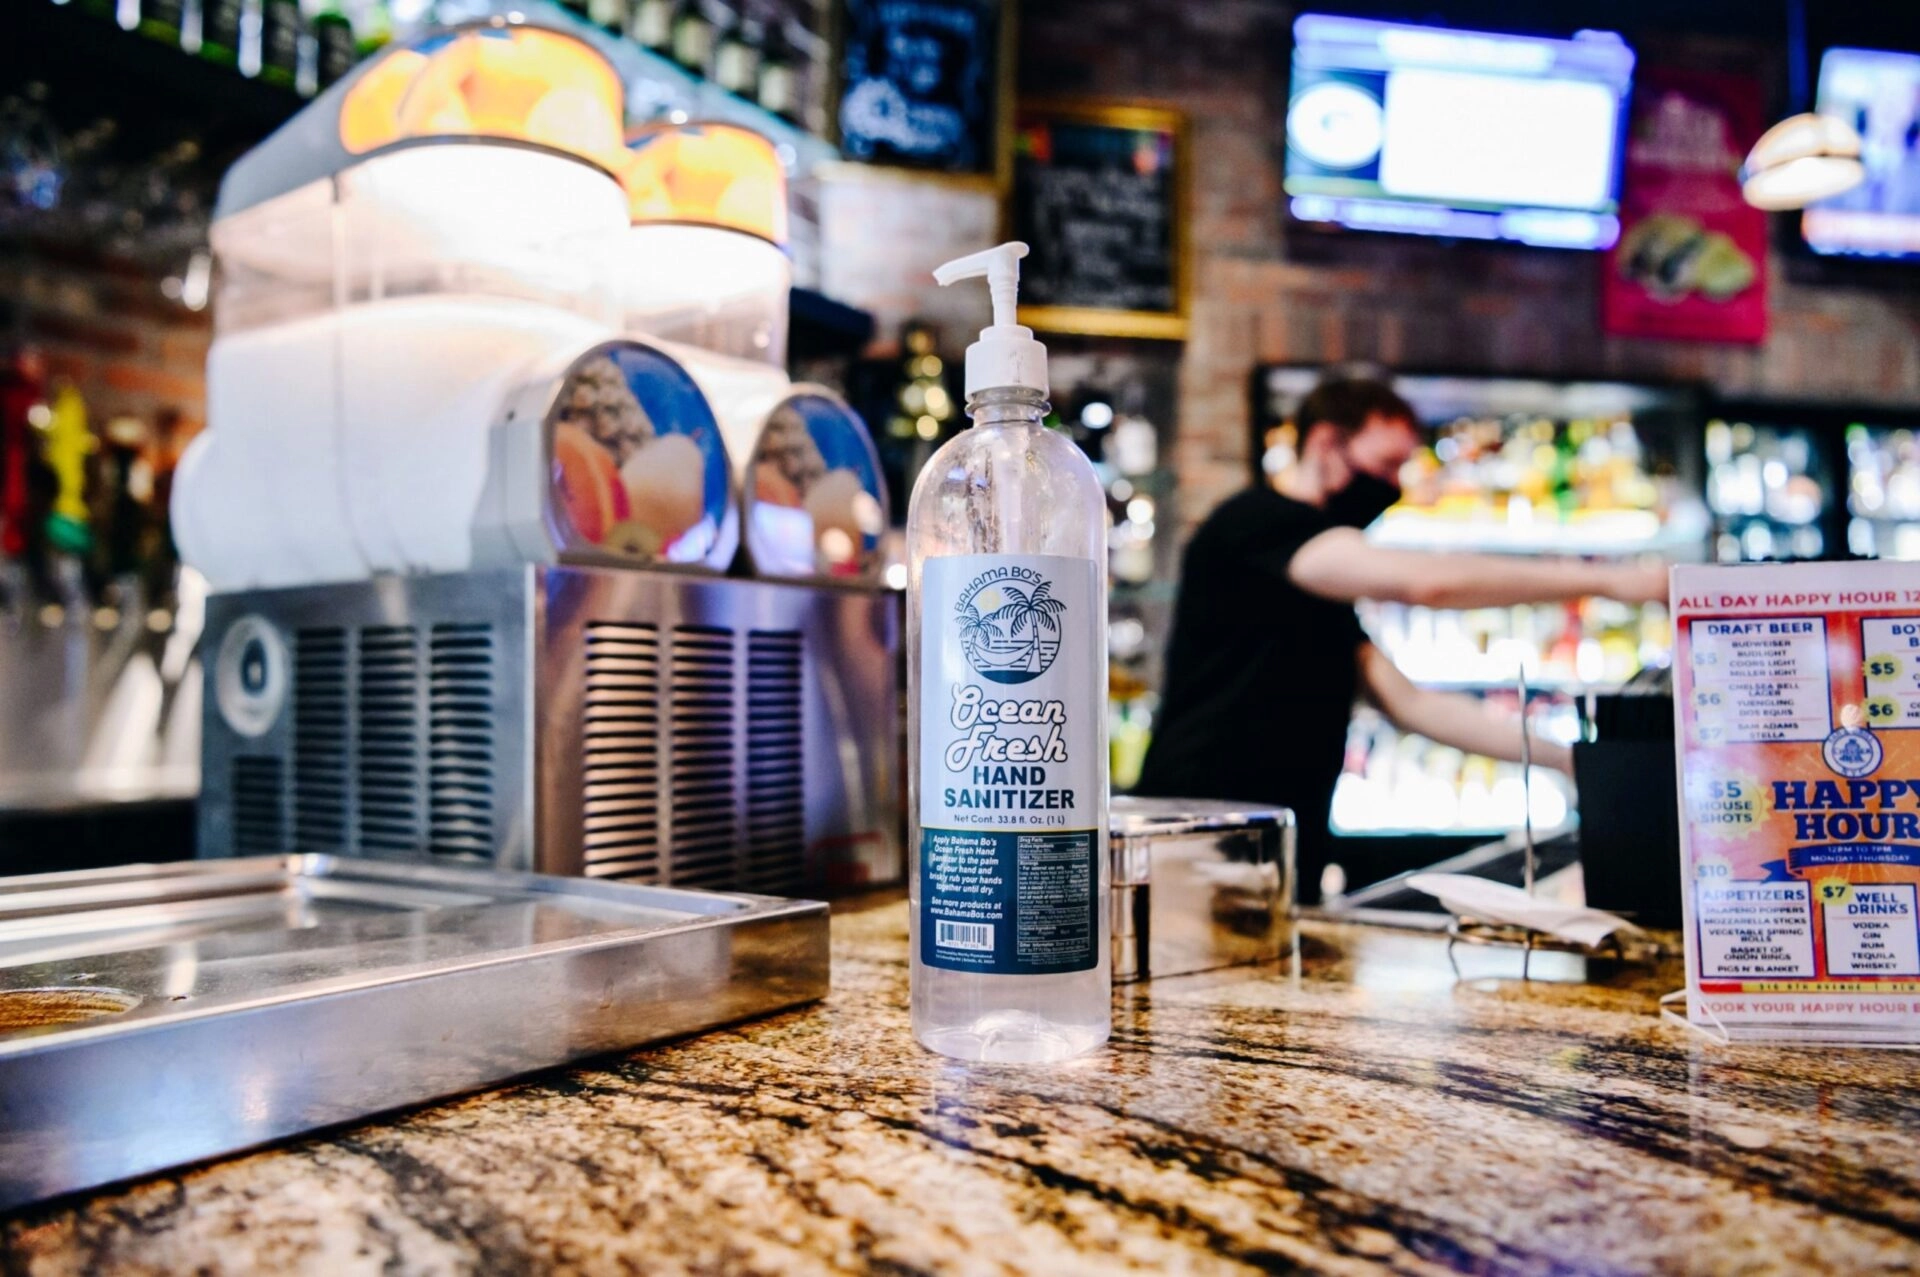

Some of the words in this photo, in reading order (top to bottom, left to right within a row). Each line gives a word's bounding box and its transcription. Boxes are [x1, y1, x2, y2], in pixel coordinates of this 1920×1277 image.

[954, 567, 1008, 612] BAHAMA
[1011, 566, 1042, 584] BO'S
[1679, 596, 1713, 609] ALL
[1721, 595, 1759, 607] DAY
[1766, 593, 1832, 607] HAPPY
[1839, 591, 1896, 605] HOUR
[1708, 624, 1762, 634] DRAFT
[1769, 622, 1813, 633] BEER
[1732, 640, 1791, 648] BUDWEISER
[1870, 662, 1895, 676] $5
[1697, 693, 1721, 705] $6
[950, 682, 1066, 729] Ocean
[1868, 703, 1893, 717] $6
[1763, 709, 1793, 717] EQUIS
[945, 723, 1068, 772] Fresh
[973, 766, 1046, 785] HAND
[1708, 781, 1742, 799] $5
[944, 788, 1075, 809] SANITIZER
[1699, 801, 1753, 811] HOUSE
[954, 814, 969, 823] Net
[971, 815, 994, 824] Cont.
[998, 816, 1016, 824] 33.8
[1700, 813, 1753, 823] SHOTS
[1793, 813, 1920, 840] HOUR
[933, 835, 950, 845] Apply
[951, 836, 978, 845] Bahama
[980, 837, 997, 846] Bo's
[934, 844, 953, 853] Ocean
[954, 846, 974, 854] Fresh
[975, 847, 995, 856] Hand
[958, 855, 966, 864] to
[967, 856, 979, 864] the
[980, 857, 999, 867] palm
[959, 865, 977, 873] hand
[978, 867, 993, 875] and
[1698, 865, 1727, 877] $10
[961, 876, 978, 885] your
[979, 876, 1002, 884] hands
[936, 882, 961, 892] together
[1823, 886, 1845, 898] $7
[1703, 890, 1805, 900] APPETIZERS
[1855, 892, 1898, 903] WELL
[942, 899, 959, 907] more
[960, 901, 992, 909] products
[993, 902, 1002, 910] at
[1848, 904, 1908, 915] DRINKS
[1752, 1003, 1795, 1013] YOUR
[1801, 1002, 1855, 1013] HAPPY
[1860, 1002, 1907, 1013] HOUR
